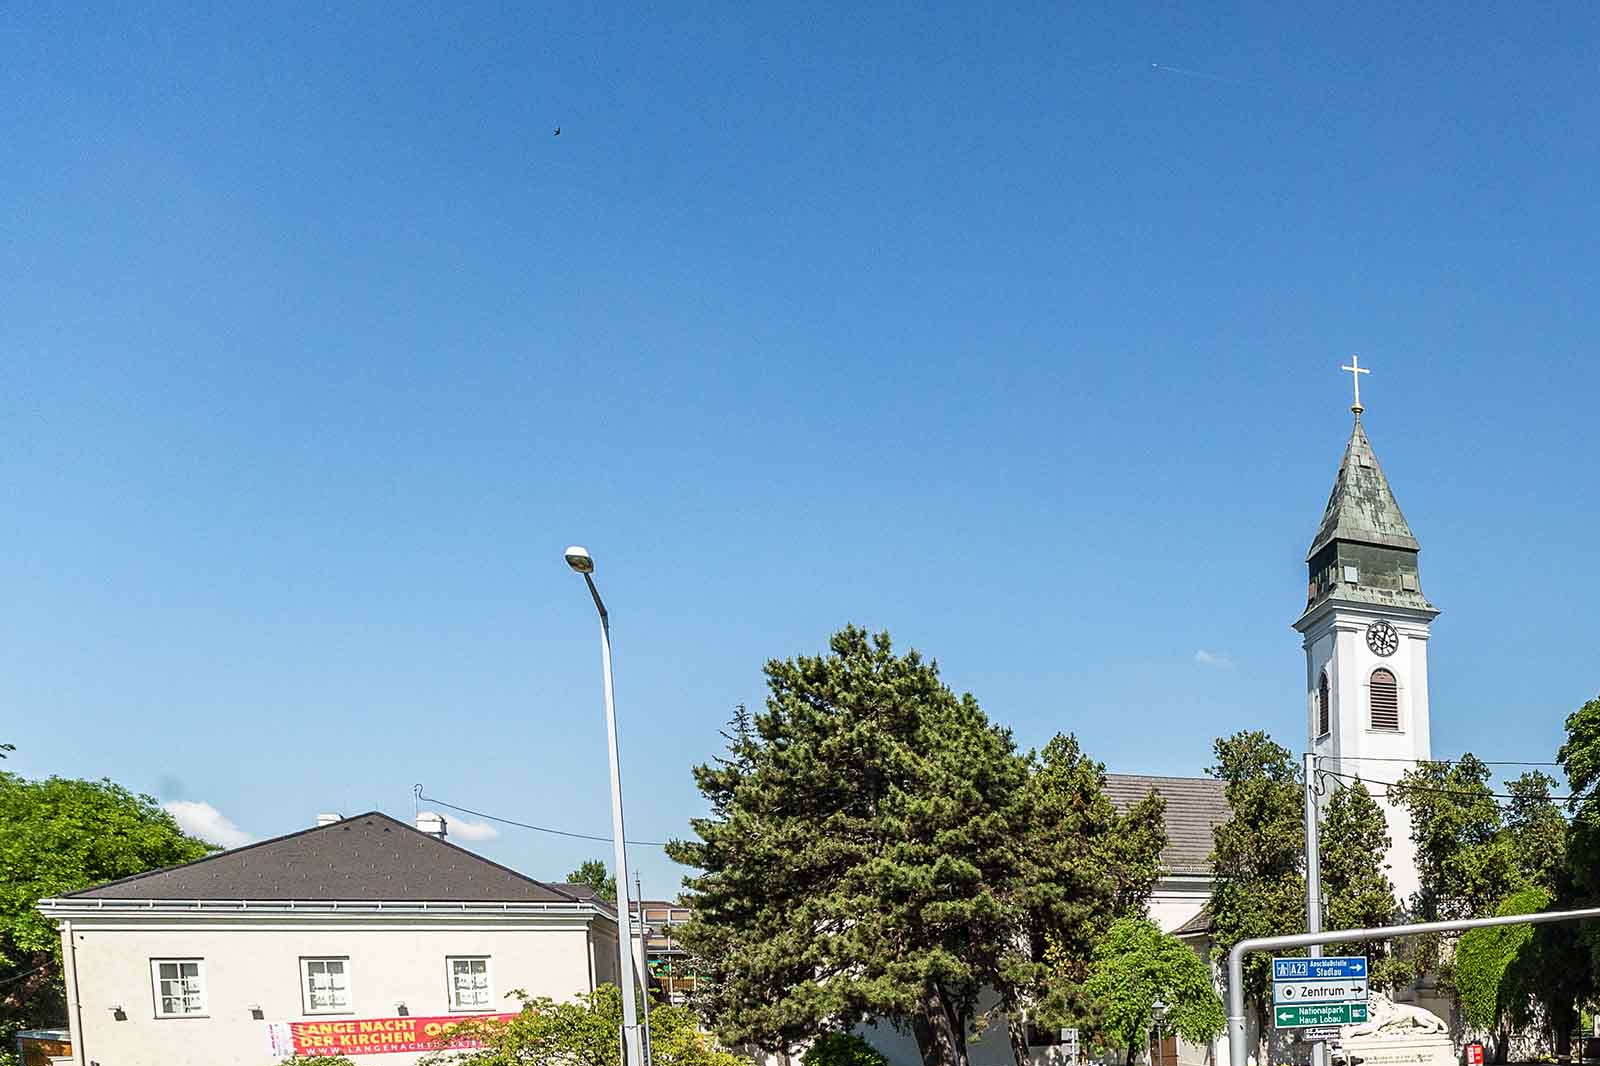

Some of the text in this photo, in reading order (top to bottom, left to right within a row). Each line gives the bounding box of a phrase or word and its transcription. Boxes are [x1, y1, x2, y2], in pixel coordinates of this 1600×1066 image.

[1291, 964, 1306, 974] A23
[1316, 967, 1342, 976] Stadlau
[1301, 987, 1345, 997] Zentrum
[1299, 1006, 1344, 1018] Nationalpark
[1299, 1015, 1341, 1024] Haus Lobau
[299, 1023, 355, 1035] LANGE
[360, 1020, 416, 1032] NACHT
[301, 1032, 416, 1047] DER KIRCHEN
